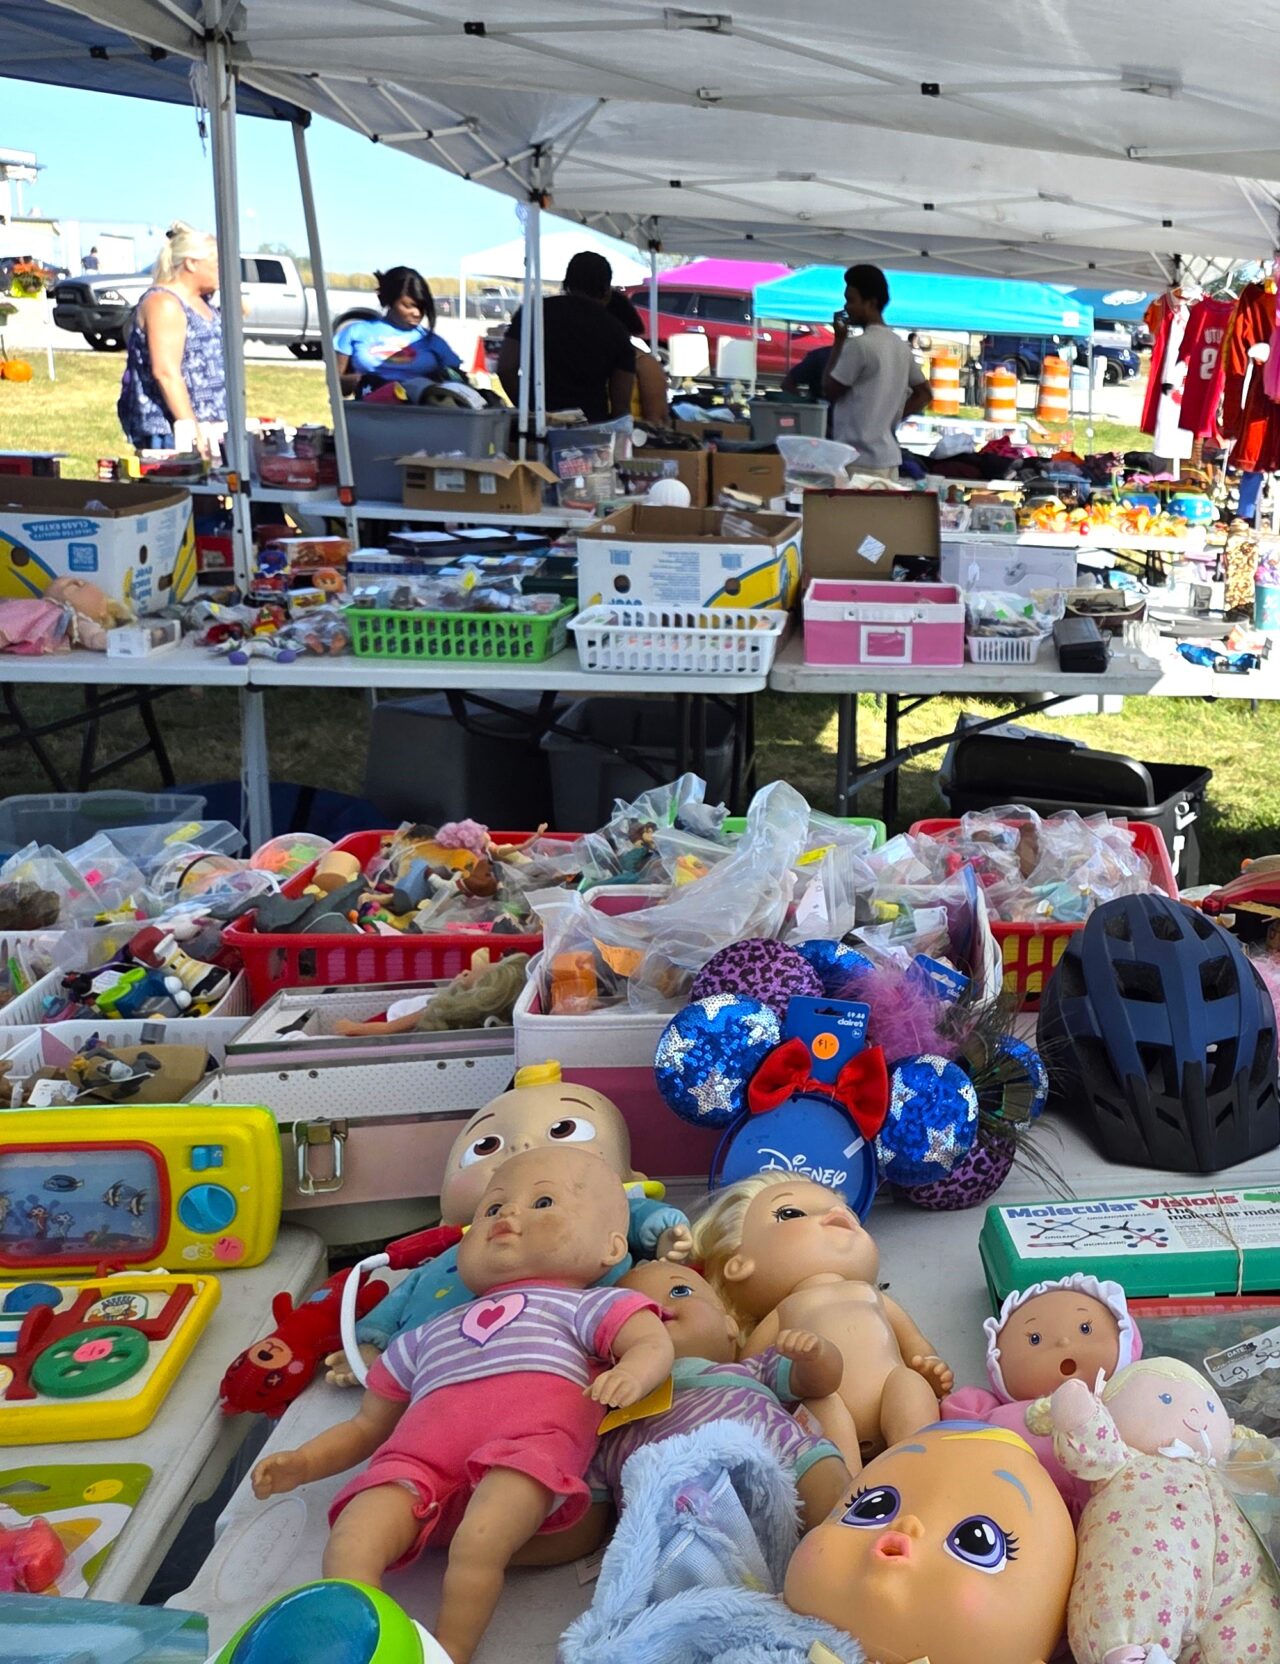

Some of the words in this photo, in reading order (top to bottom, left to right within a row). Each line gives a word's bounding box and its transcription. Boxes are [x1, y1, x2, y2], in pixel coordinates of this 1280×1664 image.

[31, 523, 60, 533] EXTRA
[837, 1018, 864, 1028] claire's
[1006, 1202, 1139, 1219] Molecular
[1139, 1194, 1239, 1211] Visions
[1164, 1207, 1194, 1216] The
[1168, 1209, 1241, 1221] molecular
